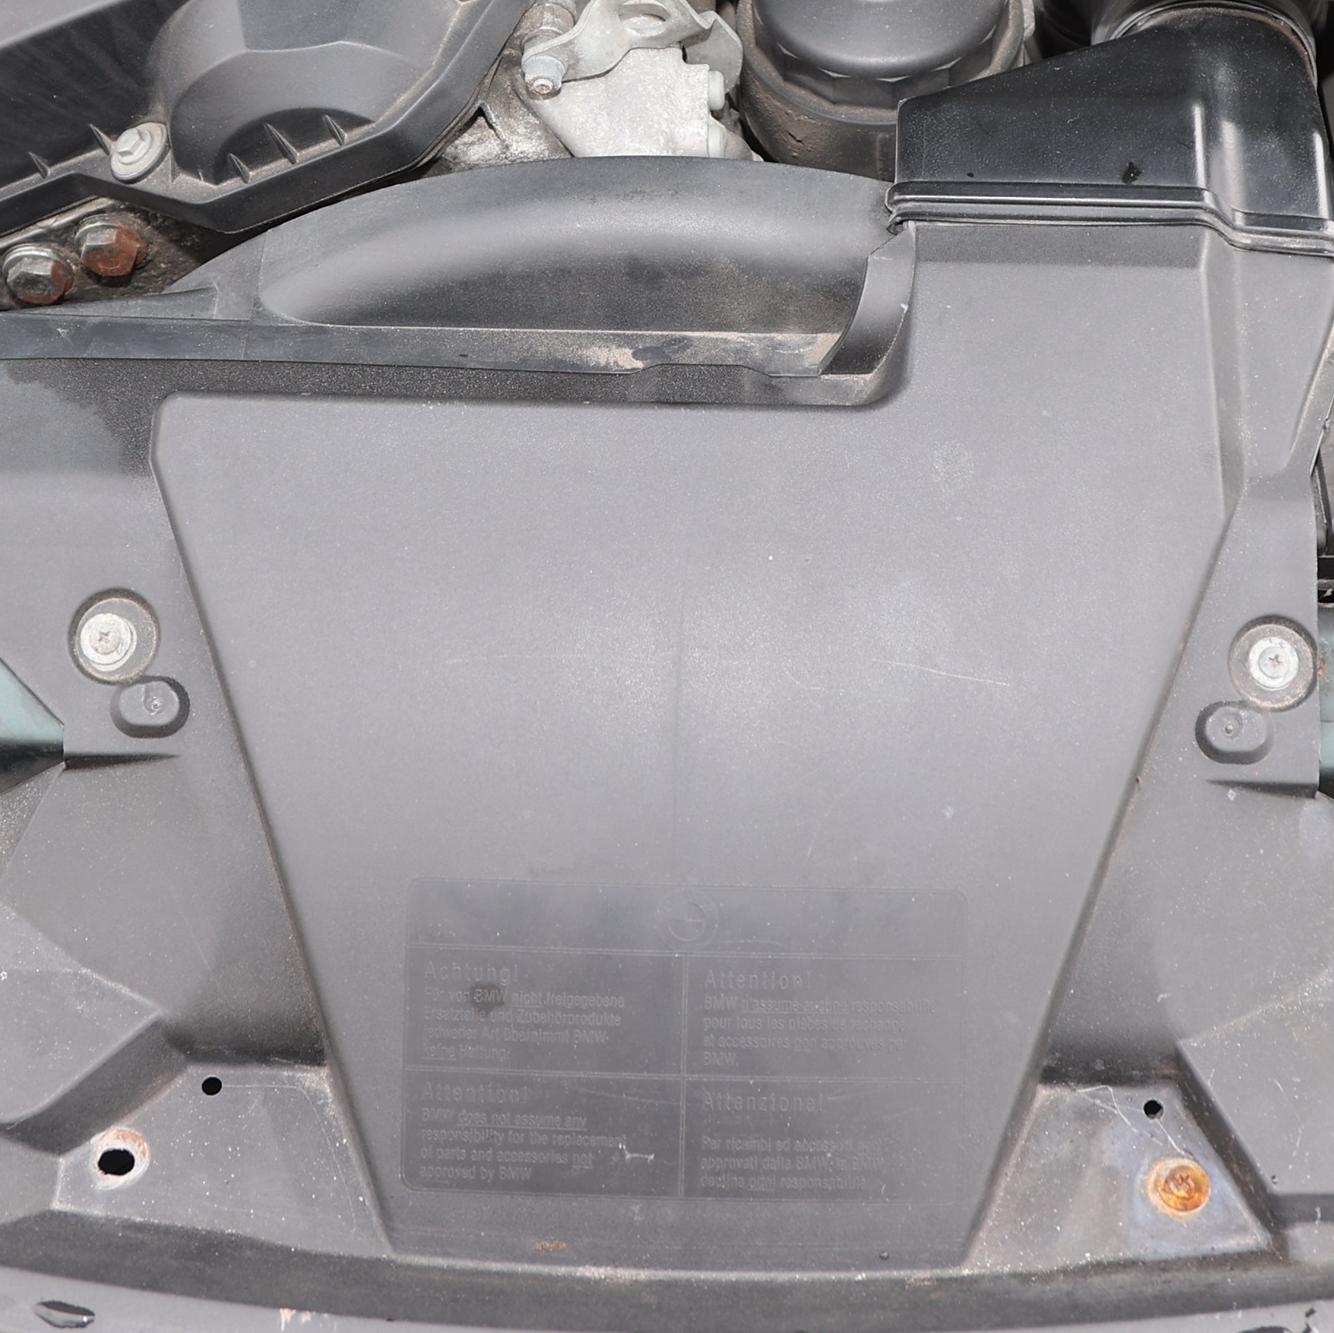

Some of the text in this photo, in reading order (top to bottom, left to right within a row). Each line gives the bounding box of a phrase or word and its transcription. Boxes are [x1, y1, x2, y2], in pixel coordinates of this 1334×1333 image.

[424, 960, 519, 987] Achtung!
[704, 969, 811, 991] Attention!
[449, 991, 470, 1003] von
[473, 988, 508, 1004] BMW
[512, 991, 543, 1006] nicht
[704, 993, 738, 1011] BMW
[490, 1009, 512, 1023] und
[574, 1029, 607, 1044] BMW
[704, 1091, 824, 1112] Attenzione!
[515, 1113, 561, 1127] assume
[565, 1115, 587, 1129] any
[508, 1130, 525, 1144] for
[530, 1131, 548, 1145] the
[436, 1147, 467, 1163] parts
[470, 1148, 492, 1161] and
[496, 1149, 568, 1164] accessories
[480, 1166, 495, 1182] by
